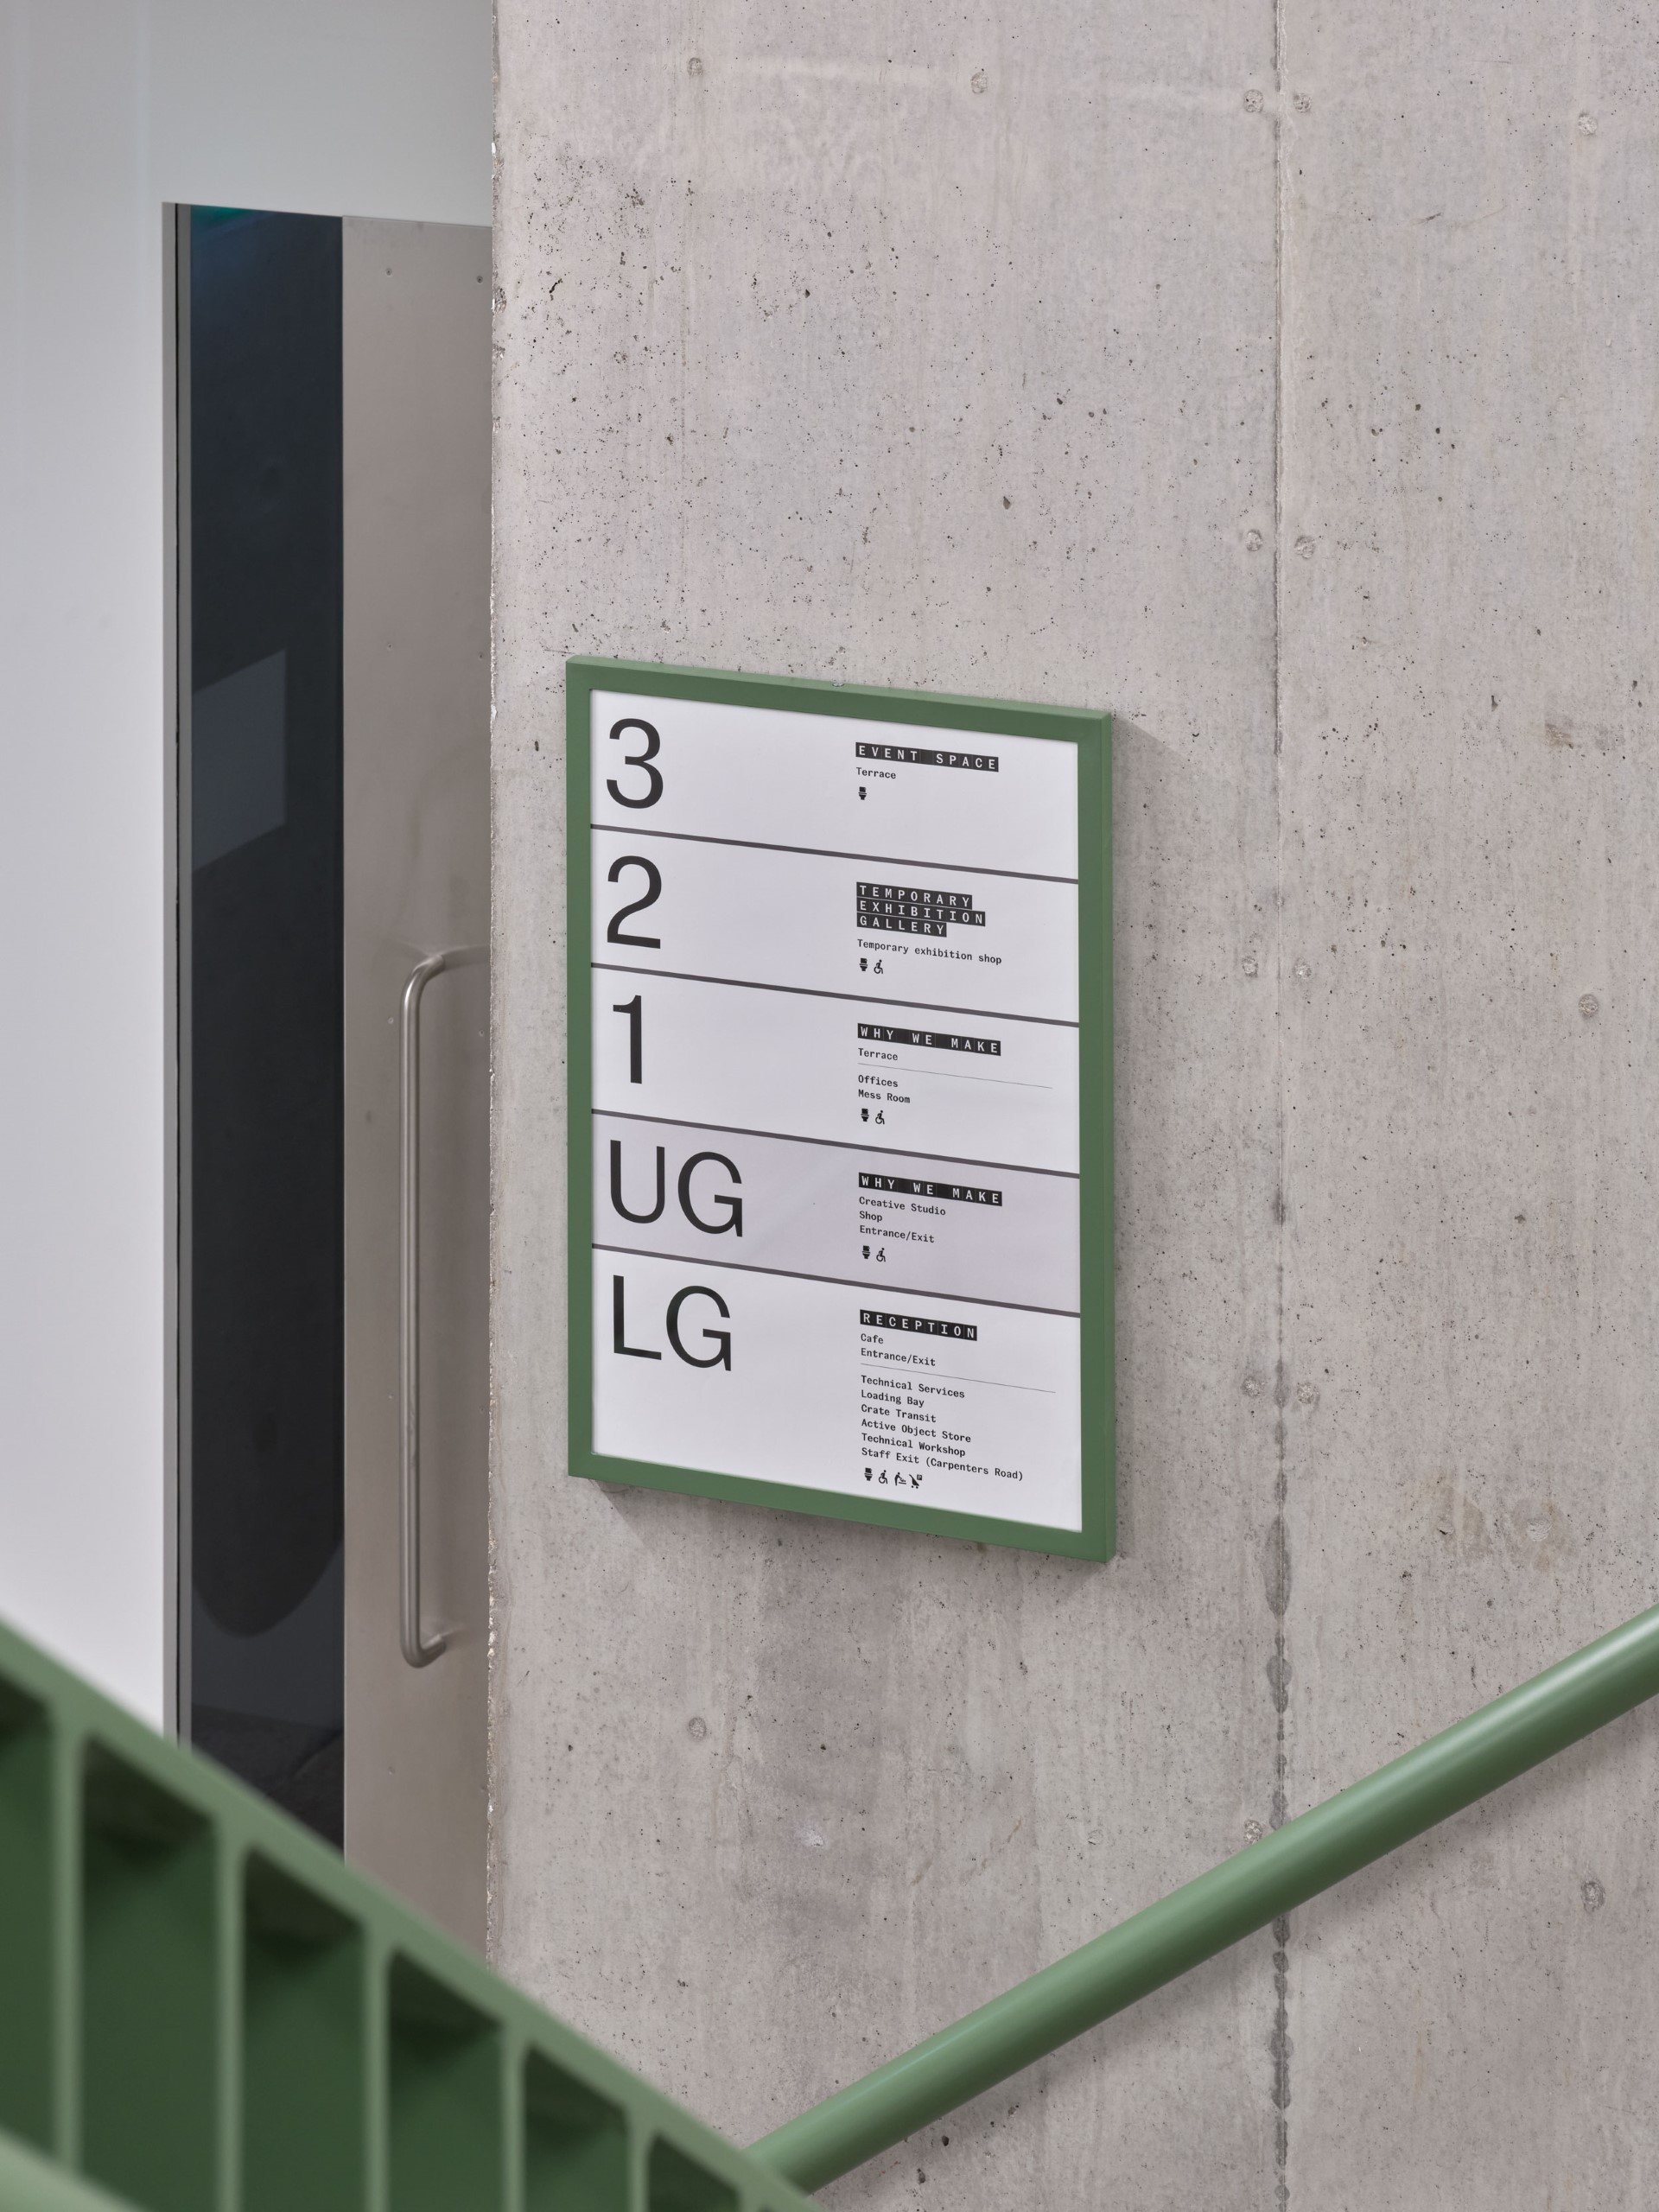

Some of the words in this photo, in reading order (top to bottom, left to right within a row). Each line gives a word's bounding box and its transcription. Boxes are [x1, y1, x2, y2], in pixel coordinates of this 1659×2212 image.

[606, 718, 664, 809] 3
[860, 746, 918, 761] EVENT
[937, 753, 995, 769] SPACE
[856, 767, 896, 779] Terrace
[606, 855, 662, 950] 2
[860, 886, 969, 907] TEMPORARY
[861, 901, 982, 924] EXHIBITION
[860, 916, 944, 934] GALLERY
[857, 939, 908, 954] Temporary
[915, 945, 972, 961] exhibition
[978, 953, 1001, 964] shop
[612, 995, 642, 1084] 1
[861, 1027, 893, 1039] WHY
[912, 1033, 931, 1045] WE
[951, 1038, 997, 1052] MAKE
[858, 1048, 898, 1061] Terrace
[858, 1075, 899, 1087] Offices
[858, 1089, 881, 1100] Mess
[887, 1093, 911, 1103] Room
[610, 1139, 744, 1237] UG
[861, 1176, 895, 1189] WHY
[913, 1183, 933, 1194] WE
[952, 1188, 999, 1203] MAKE
[859, 1197, 906, 1211] Creative
[911, 1203, 946, 1216] Studio
[859, 1211, 883, 1223] Shop
[860, 1225, 935, 1243] Entrance/Exit
[613, 1274, 733, 1371] LG
[863, 1313, 974, 1338] RECEPTION
[861, 1334, 884, 1344] Cafe
[861, 1348, 936, 1366] Entrance/Exit
[861, 1376, 912, 1390] Technical
[918, 1384, 965, 1398] Services
[861, 1389, 901, 1405] Loading
[907, 1397, 925, 1408] Bay
[861, 1405, 890, 1415] Crate
[896, 1409, 937, 1422] Transit
[861, 1419, 896, 1431] Active
[902, 1425, 937, 1438] Object
[942, 1431, 971, 1442] Store
[861, 1433, 913, 1448] Technical
[918, 1442, 965, 1457] Workshop
[861, 1448, 891, 1459] Staff
[896, 1453, 919, 1464] Exit
[926, 1458, 988, 1475] (Carpenters
[995, 1468, 1023, 1481] Road)
